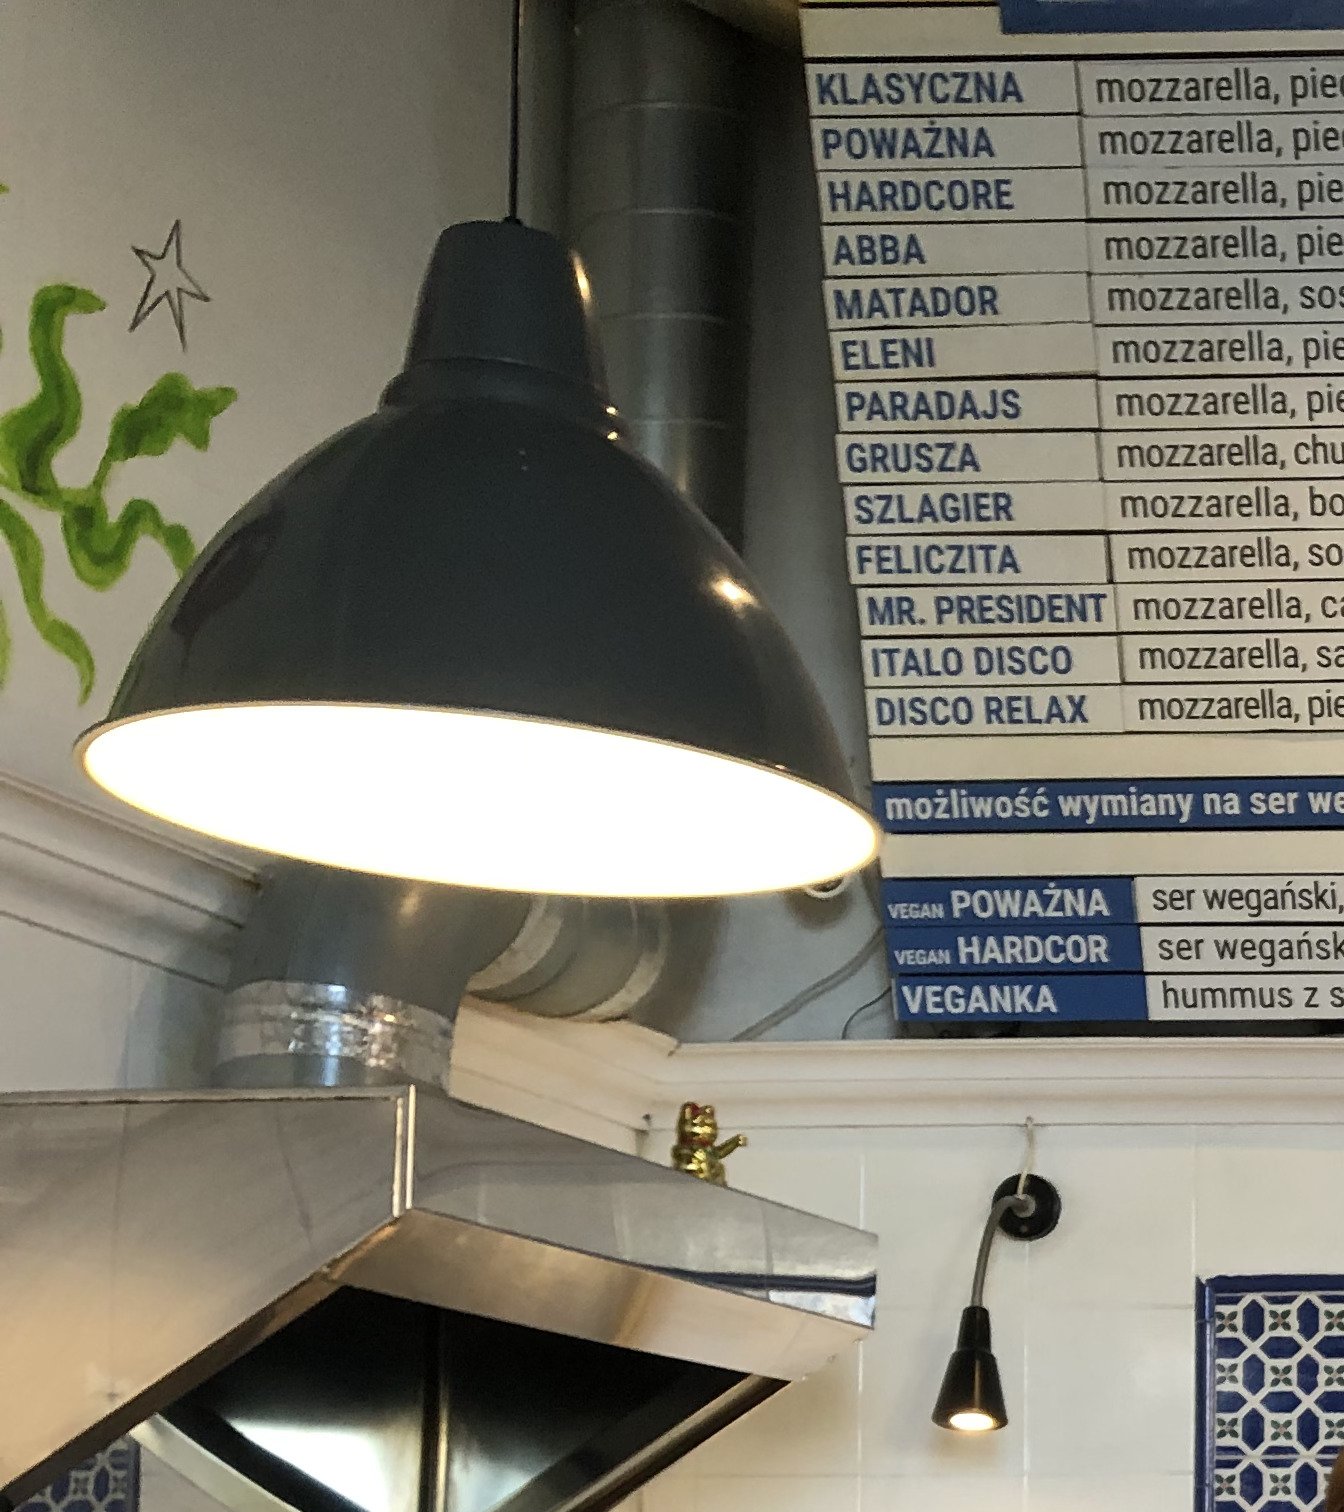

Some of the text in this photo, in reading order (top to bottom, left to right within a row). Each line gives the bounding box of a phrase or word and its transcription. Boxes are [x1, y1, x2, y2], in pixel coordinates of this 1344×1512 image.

[817, 71, 1023, 105] KLASYCZNA
[1095, 68, 1280, 107] mozzarella,
[822, 121, 995, 160] POWAŻNA
[1098, 120, 1283, 160] mozzarella,
[828, 179, 1014, 213] HARDCORE
[1103, 173, 1288, 212] mozzarella,
[834, 233, 926, 267] ABBA
[834, 286, 1000, 321] MATADOR
[841, 338, 935, 372] ELENI
[846, 389, 1022, 421] PARADAJS
[845, 441, 981, 474] GRUSZA
[854, 493, 1016, 526] SZLAGIER
[1120, 484, 1299, 523] mozzarella,
[856, 544, 1020, 575] FELICZITA
[1127, 534, 1300, 573] mozzarella,
[868, 593, 1108, 627] MR. PRESIDENT
[871, 645, 1073, 677] ITALO DISCO
[1138, 637, 1308, 675] mozzarella,
[876, 694, 1088, 726] DISCO RELAX
[885, 786, 1050, 821] możliwość
[1058, 792, 1194, 825] wymiany
[1202, 791, 1240, 815] na
[1249, 790, 1298, 814] ser
[887, 882, 1110, 920] VEGAN POWAŻNA
[1152, 889, 1196, 911] ser
[1202, 879, 1344, 920] wegański,
[894, 935, 1110, 967] VEGAN HARDCOR
[903, 984, 1057, 1015] VEGANKA
[1161, 977, 1294, 1009] hummus
[1302, 985, 1320, 1007] z
